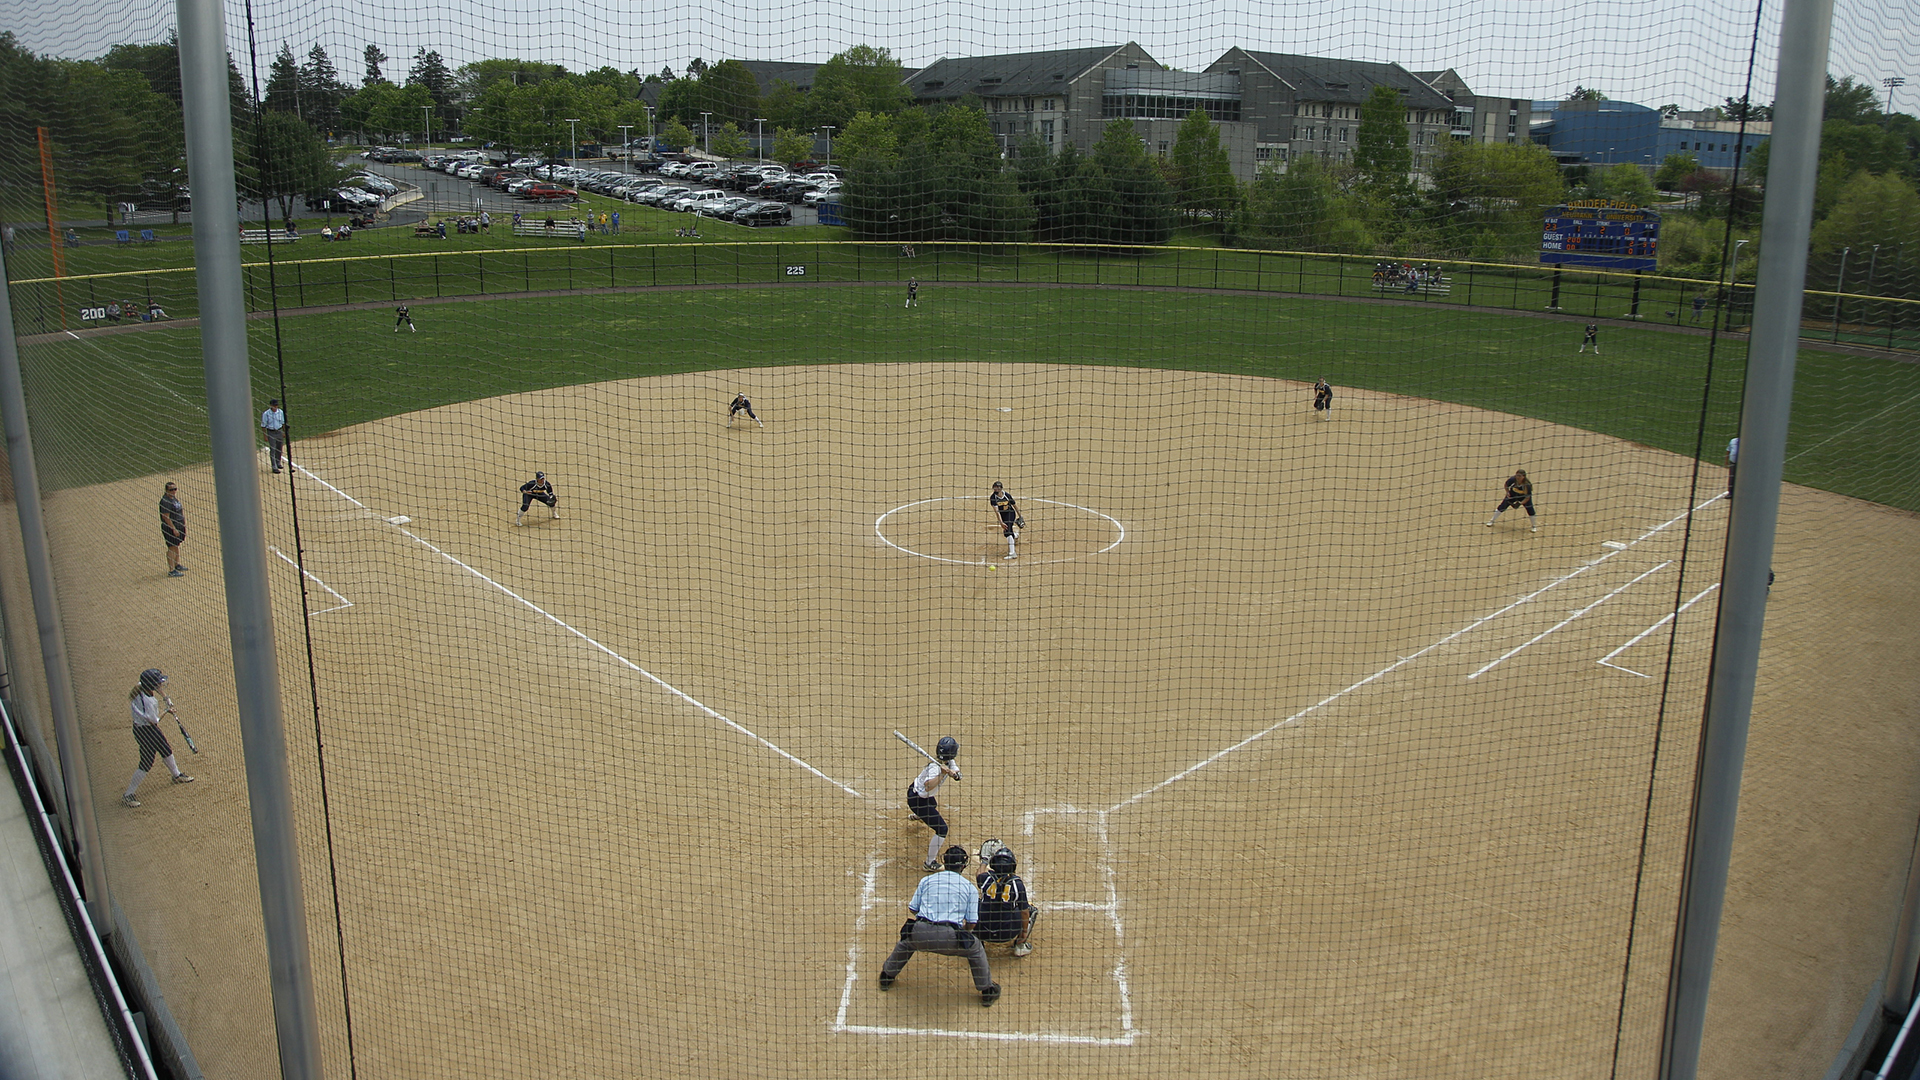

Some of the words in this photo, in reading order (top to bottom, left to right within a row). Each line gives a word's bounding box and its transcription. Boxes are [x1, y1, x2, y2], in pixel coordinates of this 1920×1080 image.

[1609, 199, 1639, 213] FIELD
[1605, 213, 1644, 221] UNIVERSITY
[1600, 226, 1605, 234] 2
[787, 266, 805, 275] 225
[81, 307, 106, 320] 200
[986, 881, 1011, 902] 44
